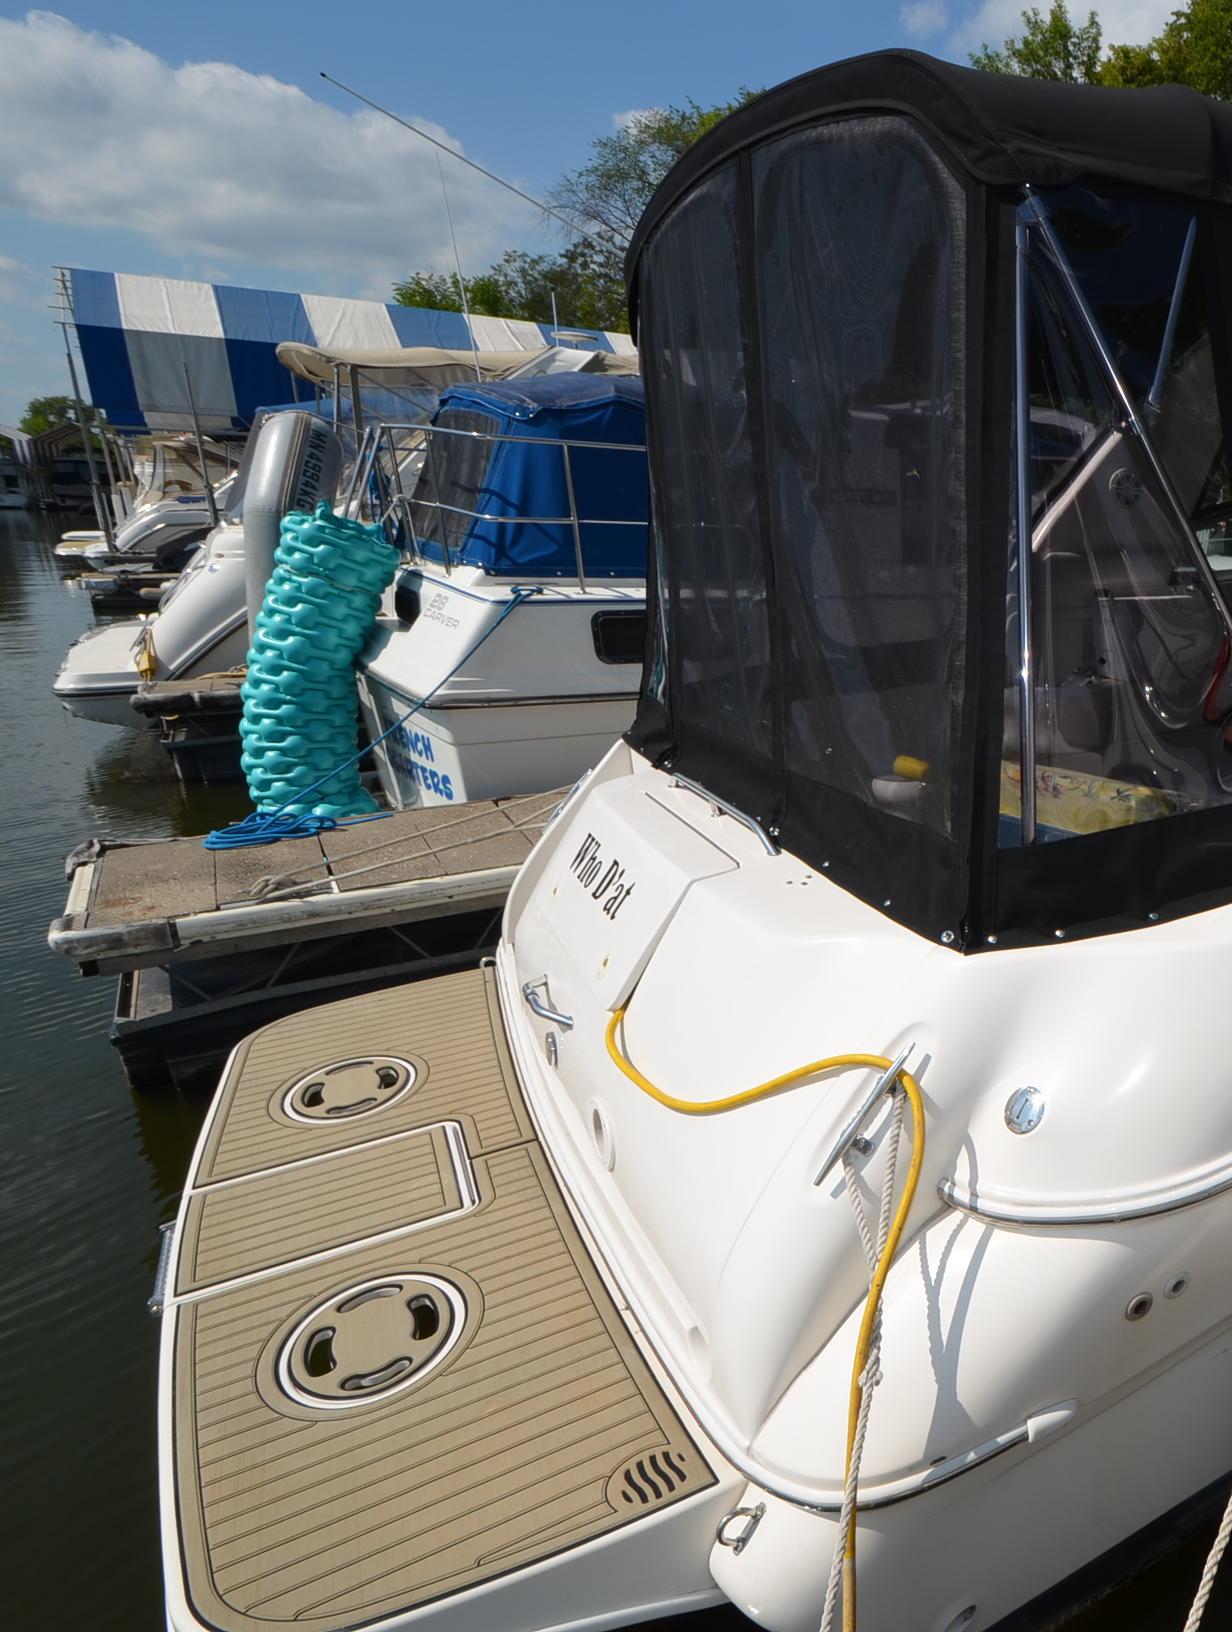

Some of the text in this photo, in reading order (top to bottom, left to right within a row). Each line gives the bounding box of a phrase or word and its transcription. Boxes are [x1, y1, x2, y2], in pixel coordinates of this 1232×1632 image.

[429, 592, 449, 611] 28
[423, 607, 461, 631] CARVER
[569, 832, 636, 921] Who D'at
